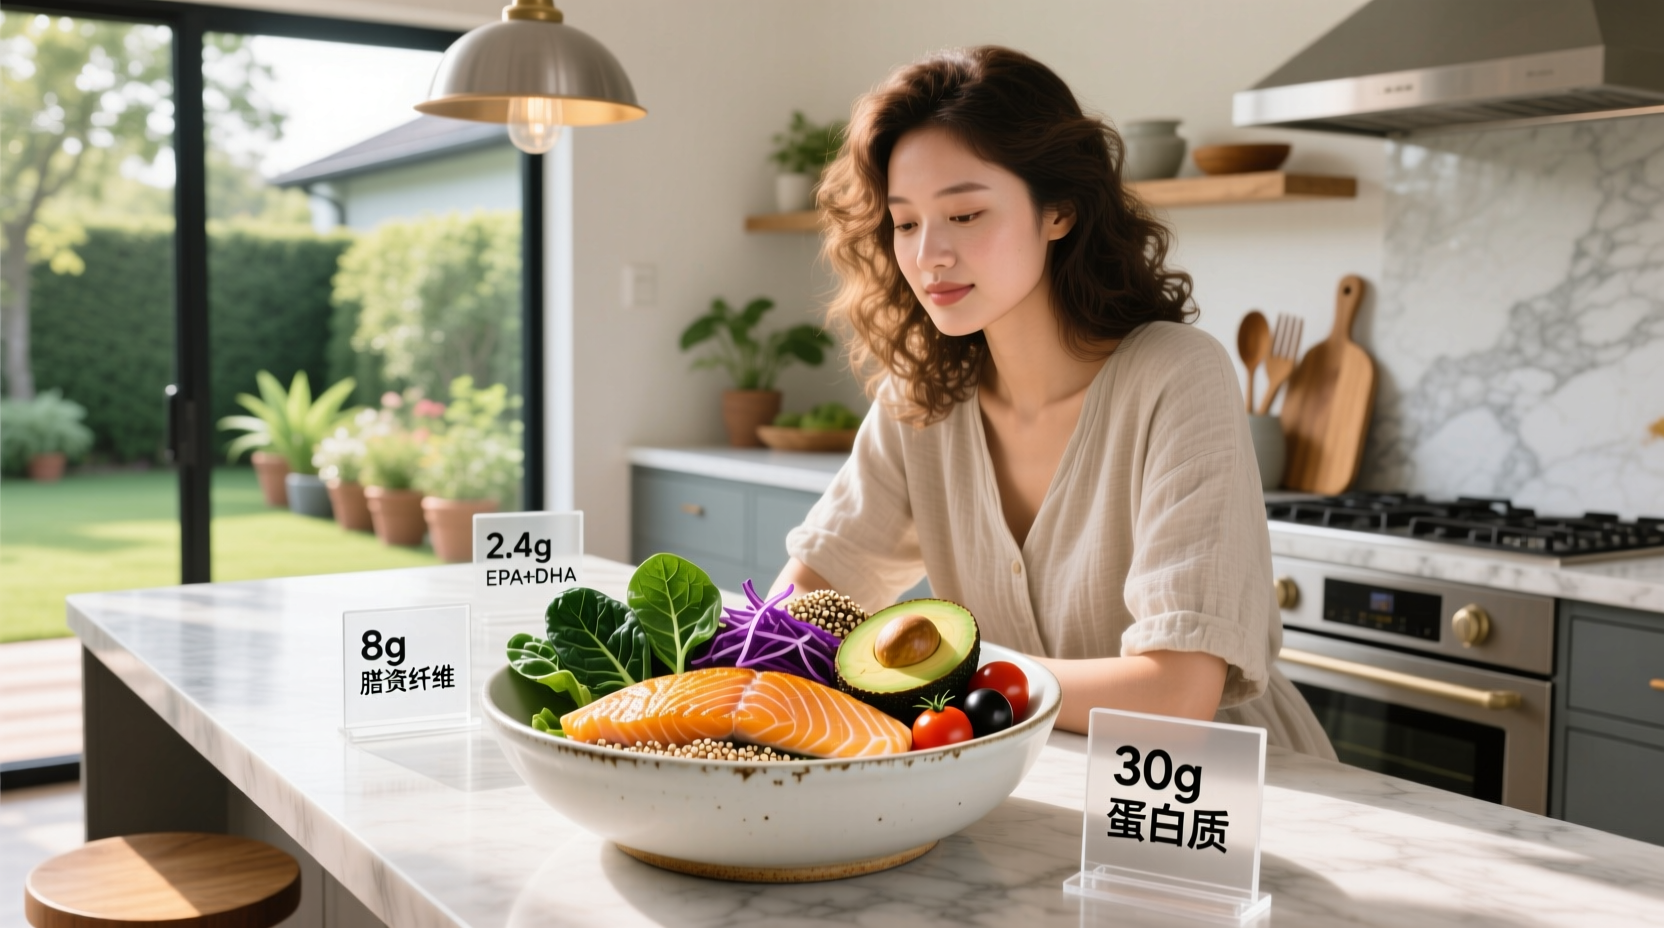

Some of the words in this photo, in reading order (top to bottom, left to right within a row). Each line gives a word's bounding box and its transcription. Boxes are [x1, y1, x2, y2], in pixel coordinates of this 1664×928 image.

[486, 531, 552, 564] 2.4g
[486, 566, 577, 587] EPA+DHA
[361, 629, 406, 667] 8g
[1113, 744, 1203, 804] 30g
[1107, 797, 1229, 854] 蛋白质
